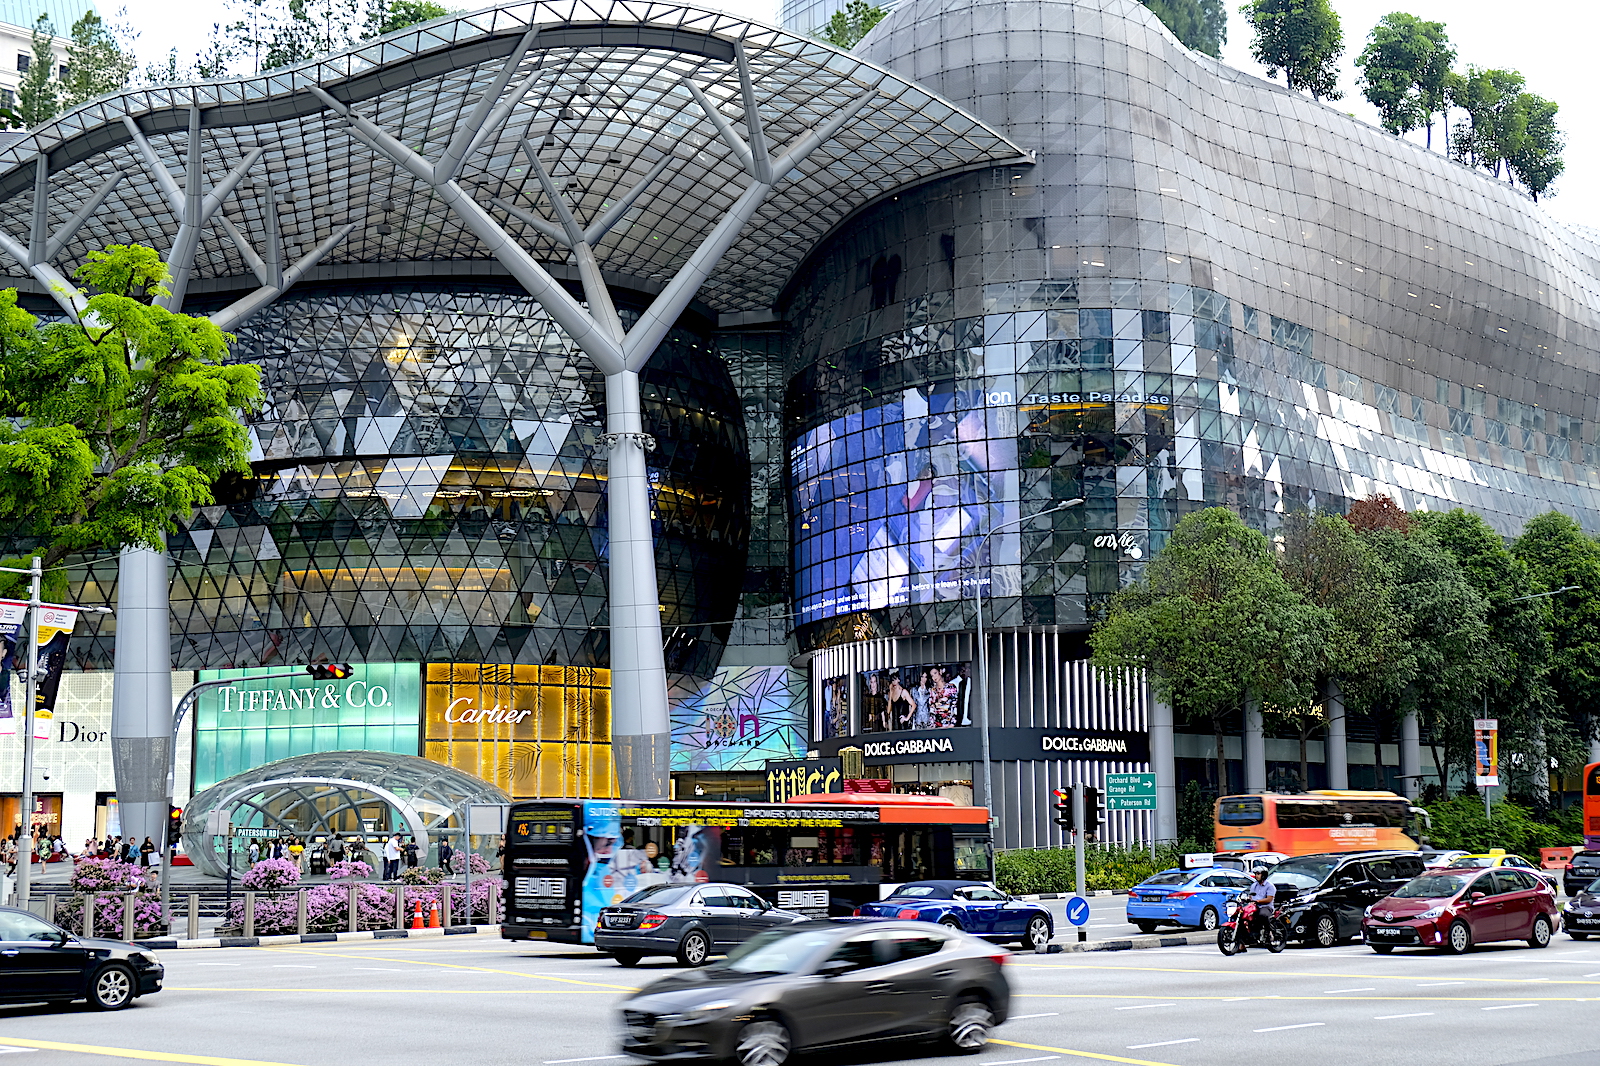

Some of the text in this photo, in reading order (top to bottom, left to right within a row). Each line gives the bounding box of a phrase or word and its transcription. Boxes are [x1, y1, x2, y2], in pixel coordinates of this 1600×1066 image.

[1028, 392, 1170, 405] Taste Paradise
[1094, 530, 1135, 550] envie
[218, 686, 319, 713] TIFFANY
[321, 684, 341, 709] &
[444, 697, 532, 724] Cartier
[57, 721, 107, 742] Dior
[1108, 776, 1141, 784] Orchard Blvd
[1108, 785, 1136, 794] Grange Rd
[1120, 798, 1151, 807] Paterson Rd
[238, 829, 277, 838] PATERSON RD
